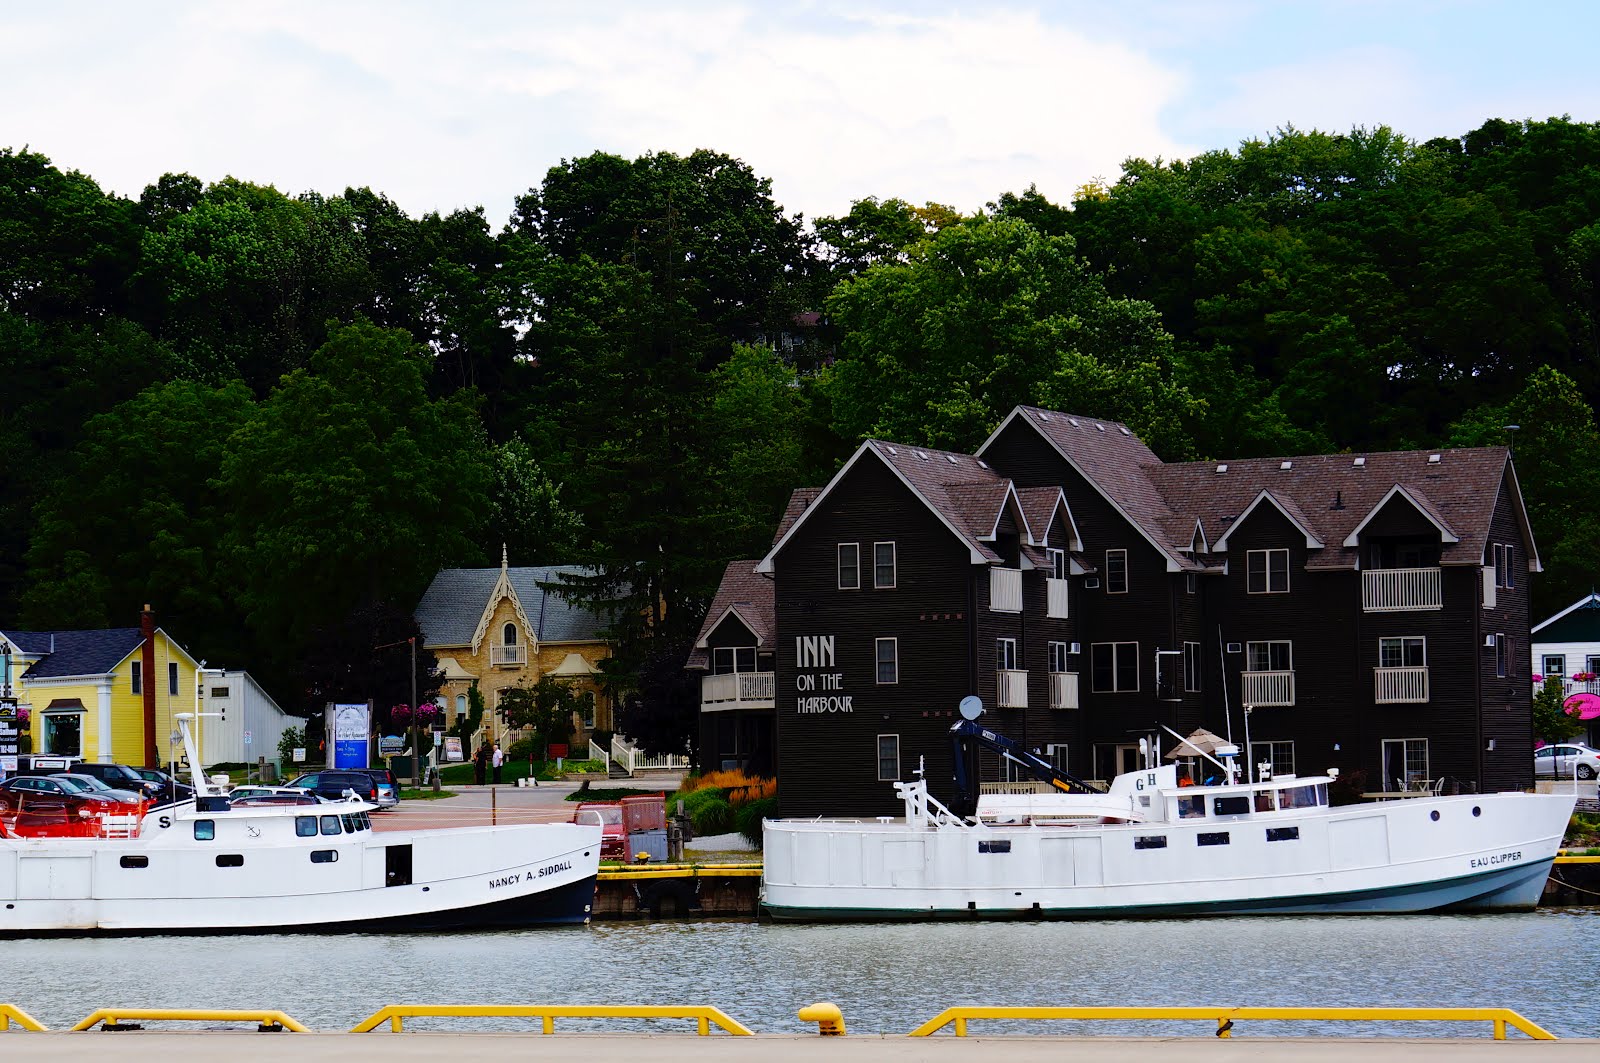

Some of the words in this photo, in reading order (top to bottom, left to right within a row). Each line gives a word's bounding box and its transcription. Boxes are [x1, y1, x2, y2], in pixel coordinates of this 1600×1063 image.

[796, 636, 835, 667] INN
[797, 675, 815, 691] ON
[820, 674, 843, 690] THE
[797, 696, 853, 713] HARBOUR
[1136, 778, 1144, 791] G
[1147, 773, 1156, 786] H
[159, 816, 171, 828] S
[1470, 856, 1489, 868] EAU
[1490, 851, 1522, 864] CLIPPER
[489, 874, 521, 889] NANCY
[526, 872, 536, 881] A.
[538, 861, 572, 877] SIDDALL
